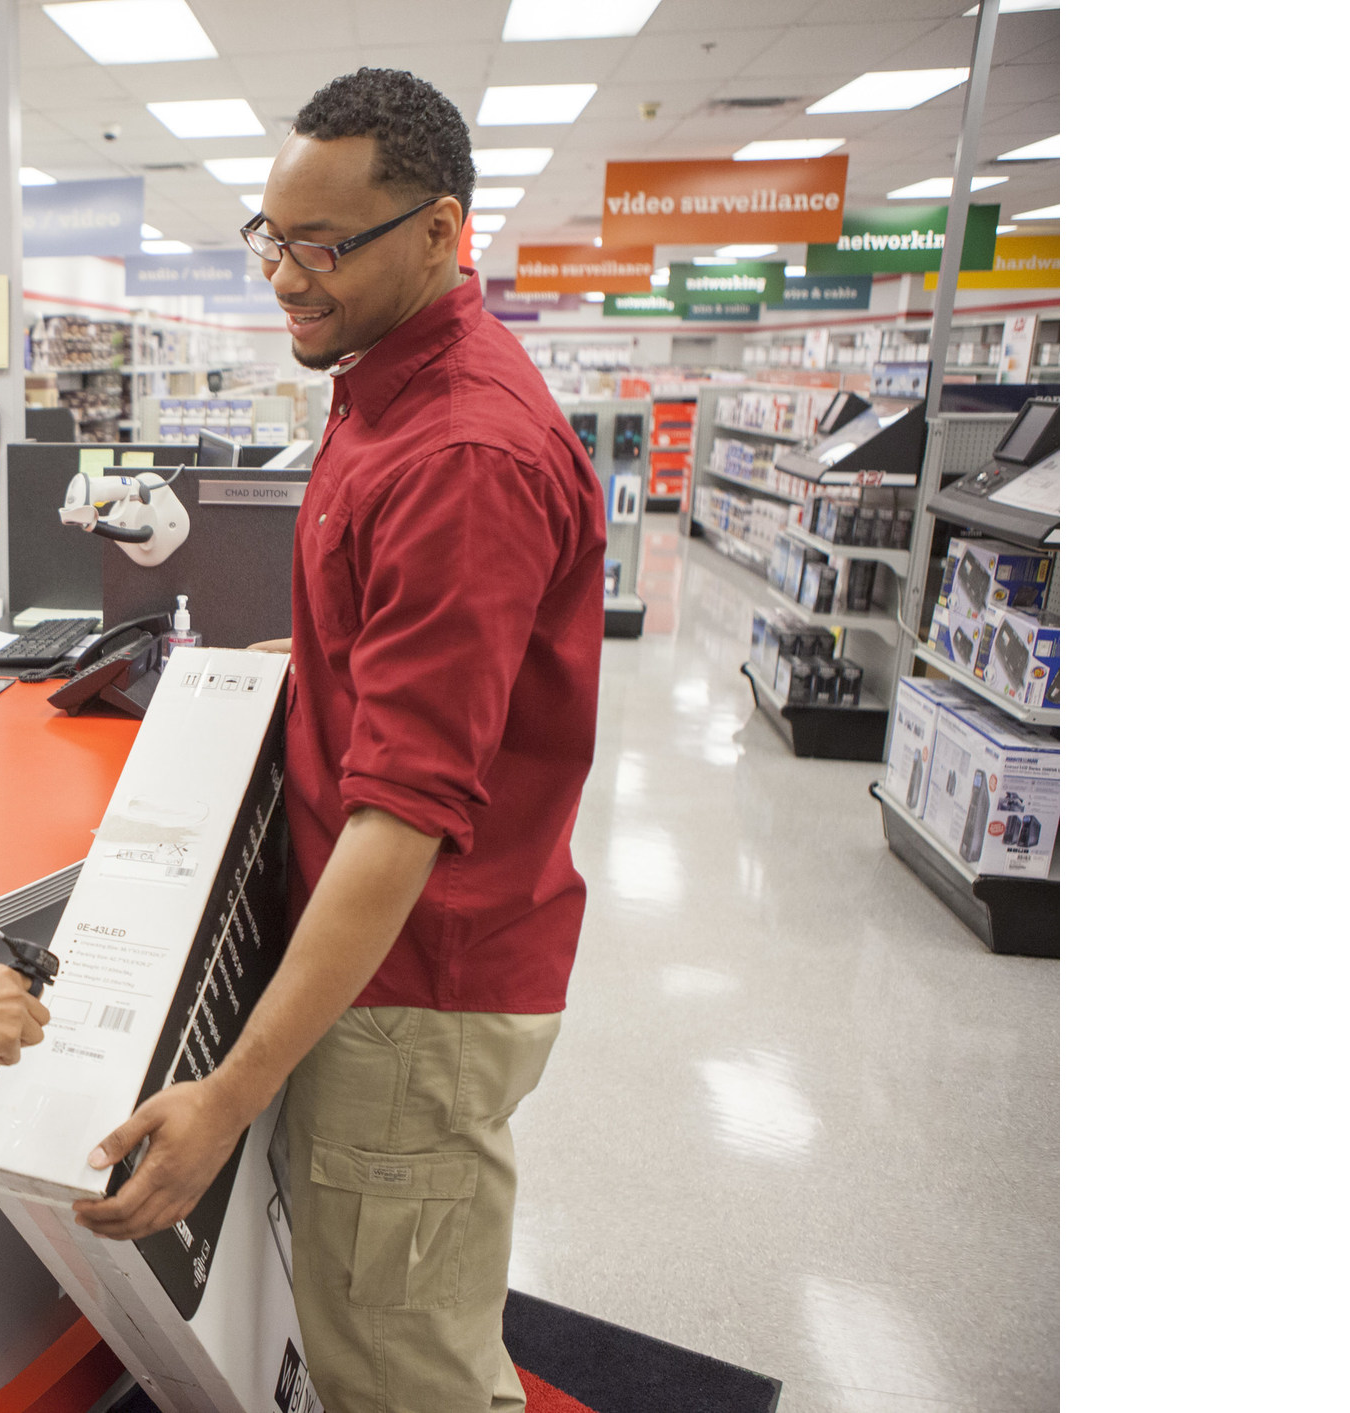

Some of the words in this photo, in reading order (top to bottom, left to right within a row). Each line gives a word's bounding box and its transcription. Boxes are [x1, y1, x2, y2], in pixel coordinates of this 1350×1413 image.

[607, 191, 674, 215] video
[680, 189, 840, 214] surveillance
[60, 208, 121, 229] video
[837, 230, 946, 251] networkin
[518, 261, 559, 278] video
[562, 260, 652, 277] surveillance
[686, 275, 766, 293] networking
[225, 488, 250, 497] CHAD
[252, 489, 288, 498] DUTTON
[76, 922, 127, 938] 0E-43LED
